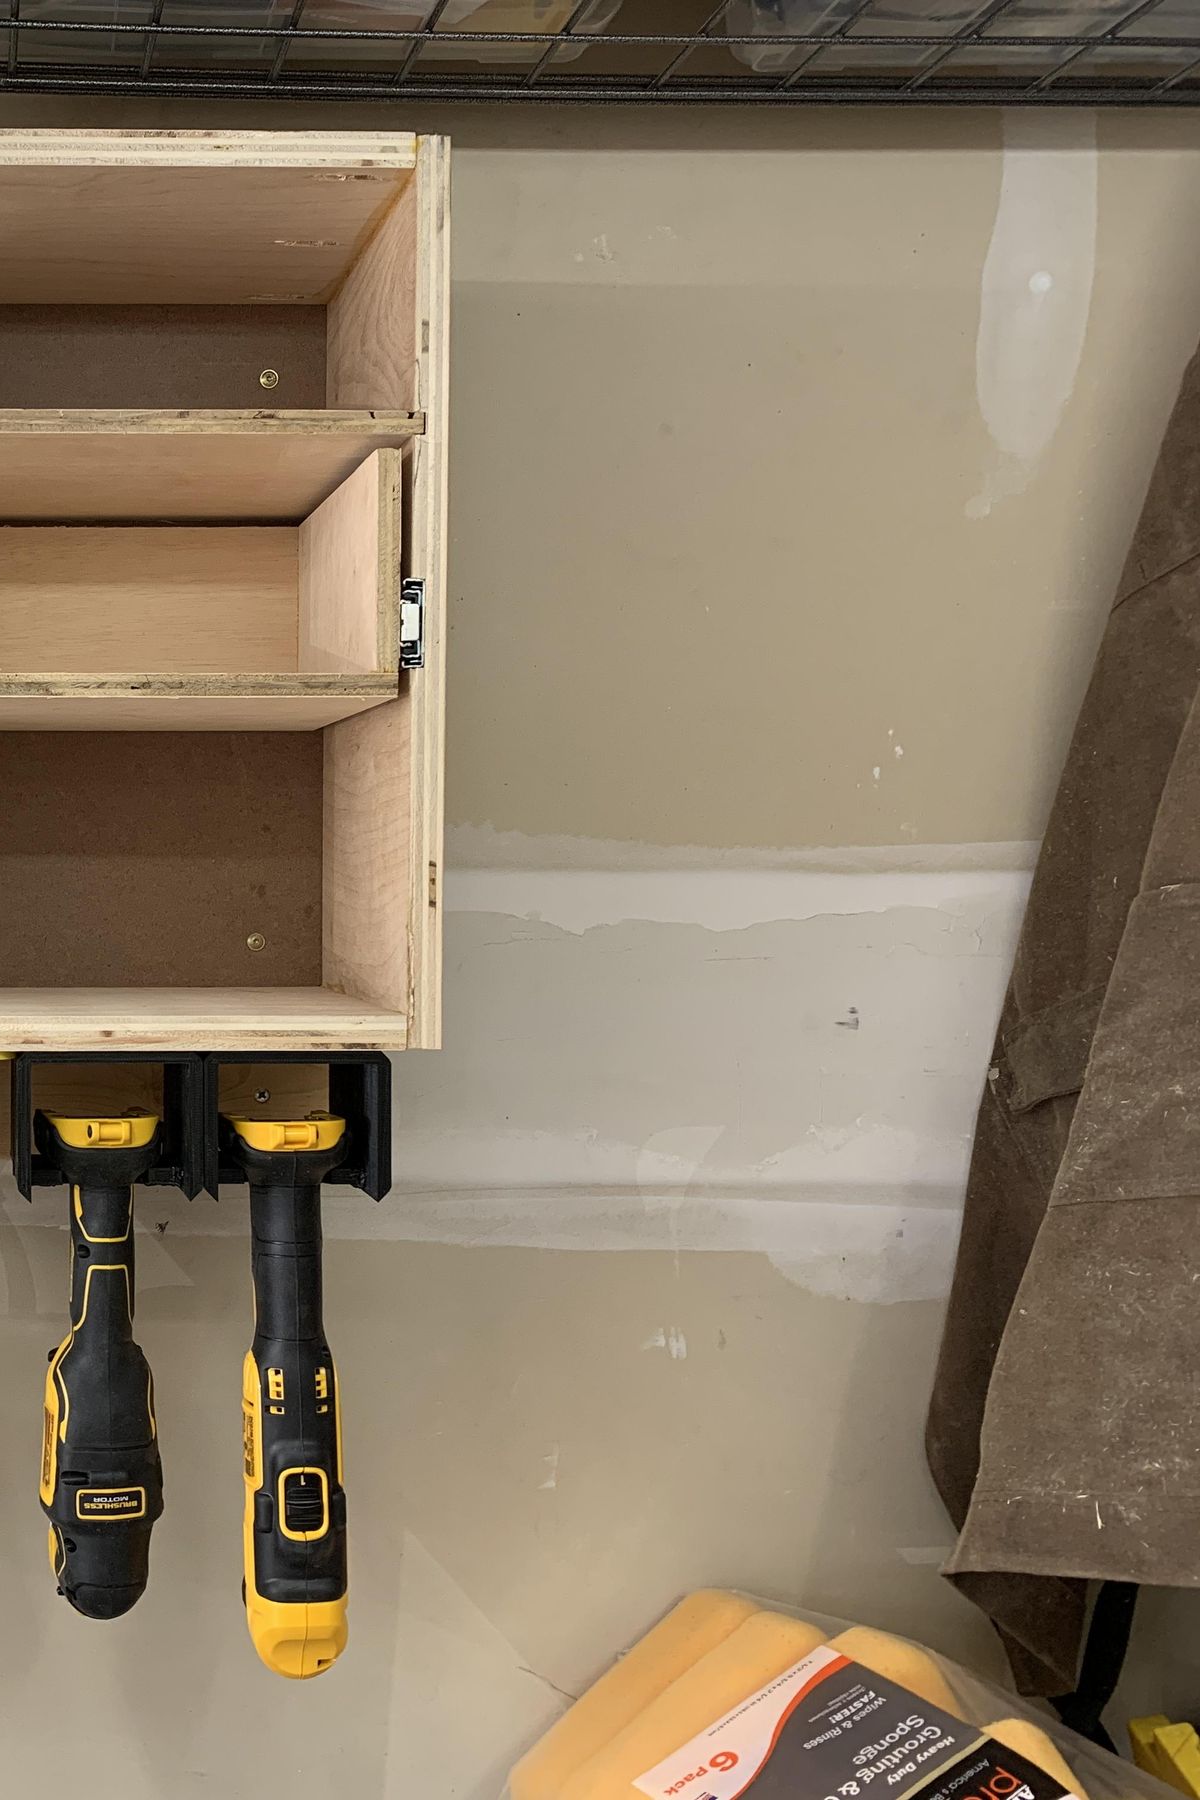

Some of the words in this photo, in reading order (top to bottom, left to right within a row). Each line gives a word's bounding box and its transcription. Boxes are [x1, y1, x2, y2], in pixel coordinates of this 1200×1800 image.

[83, 1500, 138, 1509] BRUSHLESS
[93, 1495, 129, 1503] MOTOR
[828, 1690, 876, 1724] FASTER!
[852, 1697, 887, 1722] Wipes
[841, 1720, 853, 1729] &
[803, 1726, 842, 1750] Rinses
[852, 1714, 926, 1766] Sponge
[915, 1735, 956, 1763] Heavy
[708, 1751, 739, 1773] 6
[855, 1725, 942, 1784] Grouting
[663, 1766, 709, 1797] Pack
[886, 1762, 917, 1786] Duty
[942, 1759, 990, 1796] America's
[836, 1780, 861, 1796] &
